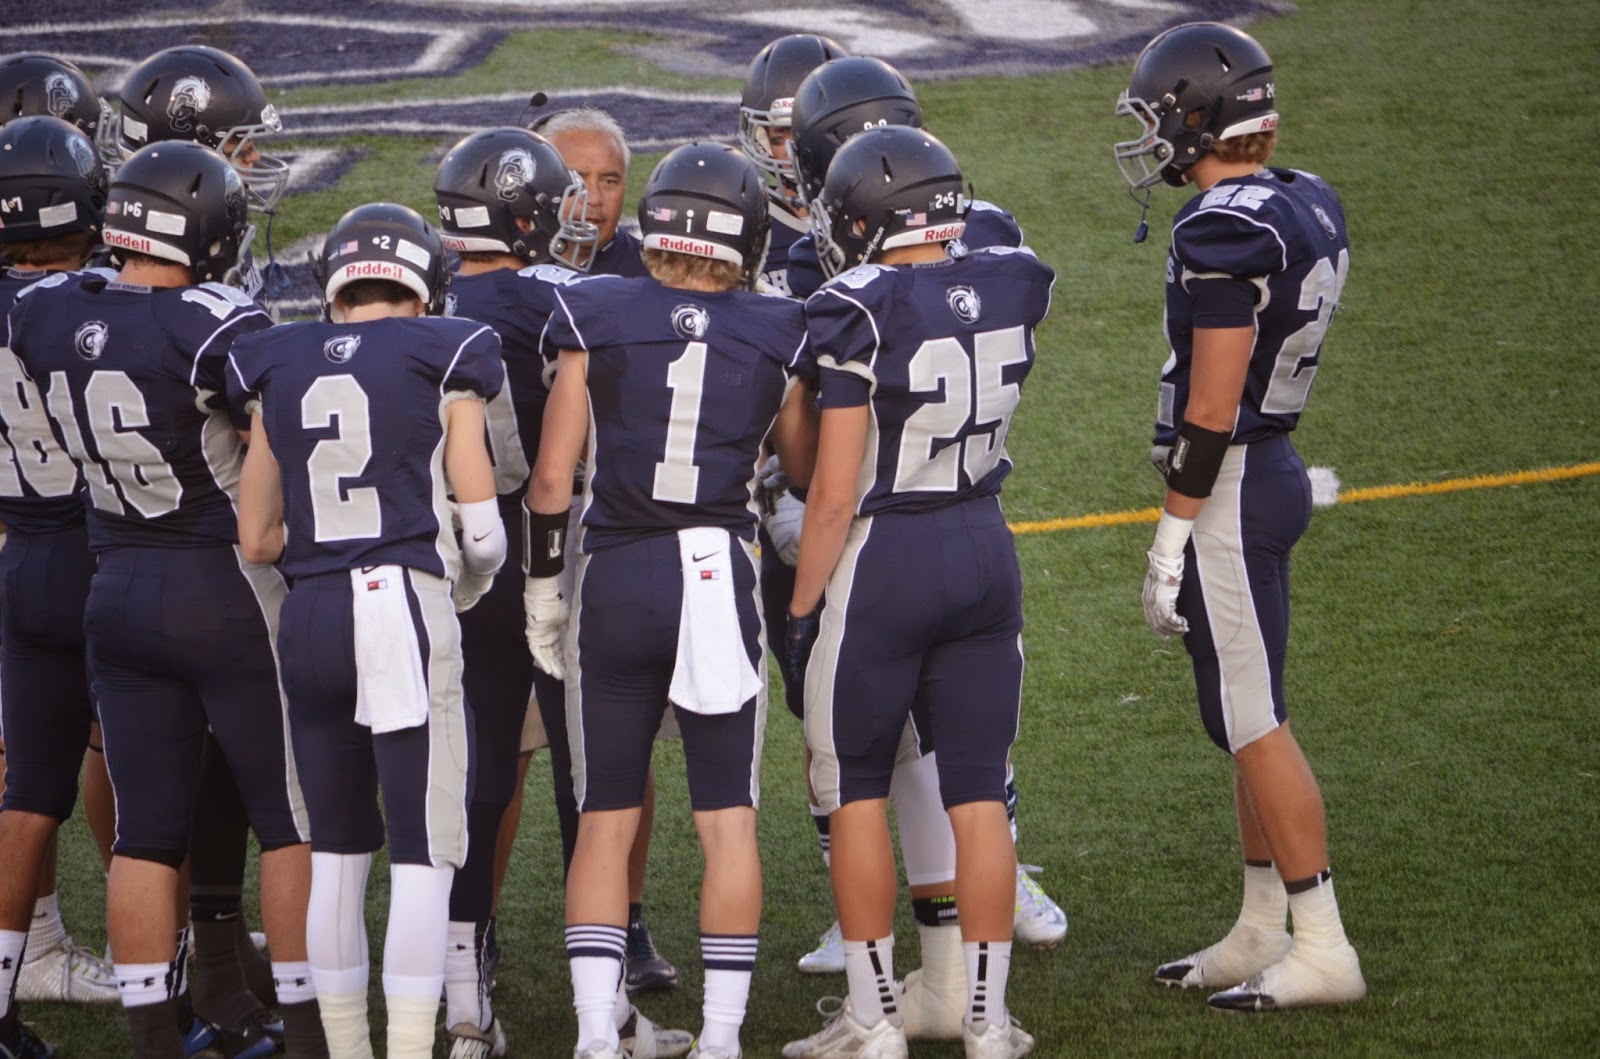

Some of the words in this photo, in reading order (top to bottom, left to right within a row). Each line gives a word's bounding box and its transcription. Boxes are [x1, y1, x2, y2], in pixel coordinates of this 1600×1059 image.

[123, 201, 143, 218] 16
[934, 191, 955, 209] 25
[105, 231, 150, 253] Riddell
[660, 237, 715, 256] Riddell
[345, 263, 403, 279] Riddell
[892, 325, 1028, 494] 25
[652, 341, 708, 504] 1
[46, 371, 183, 519] 16
[301, 374, 382, 542] 2
